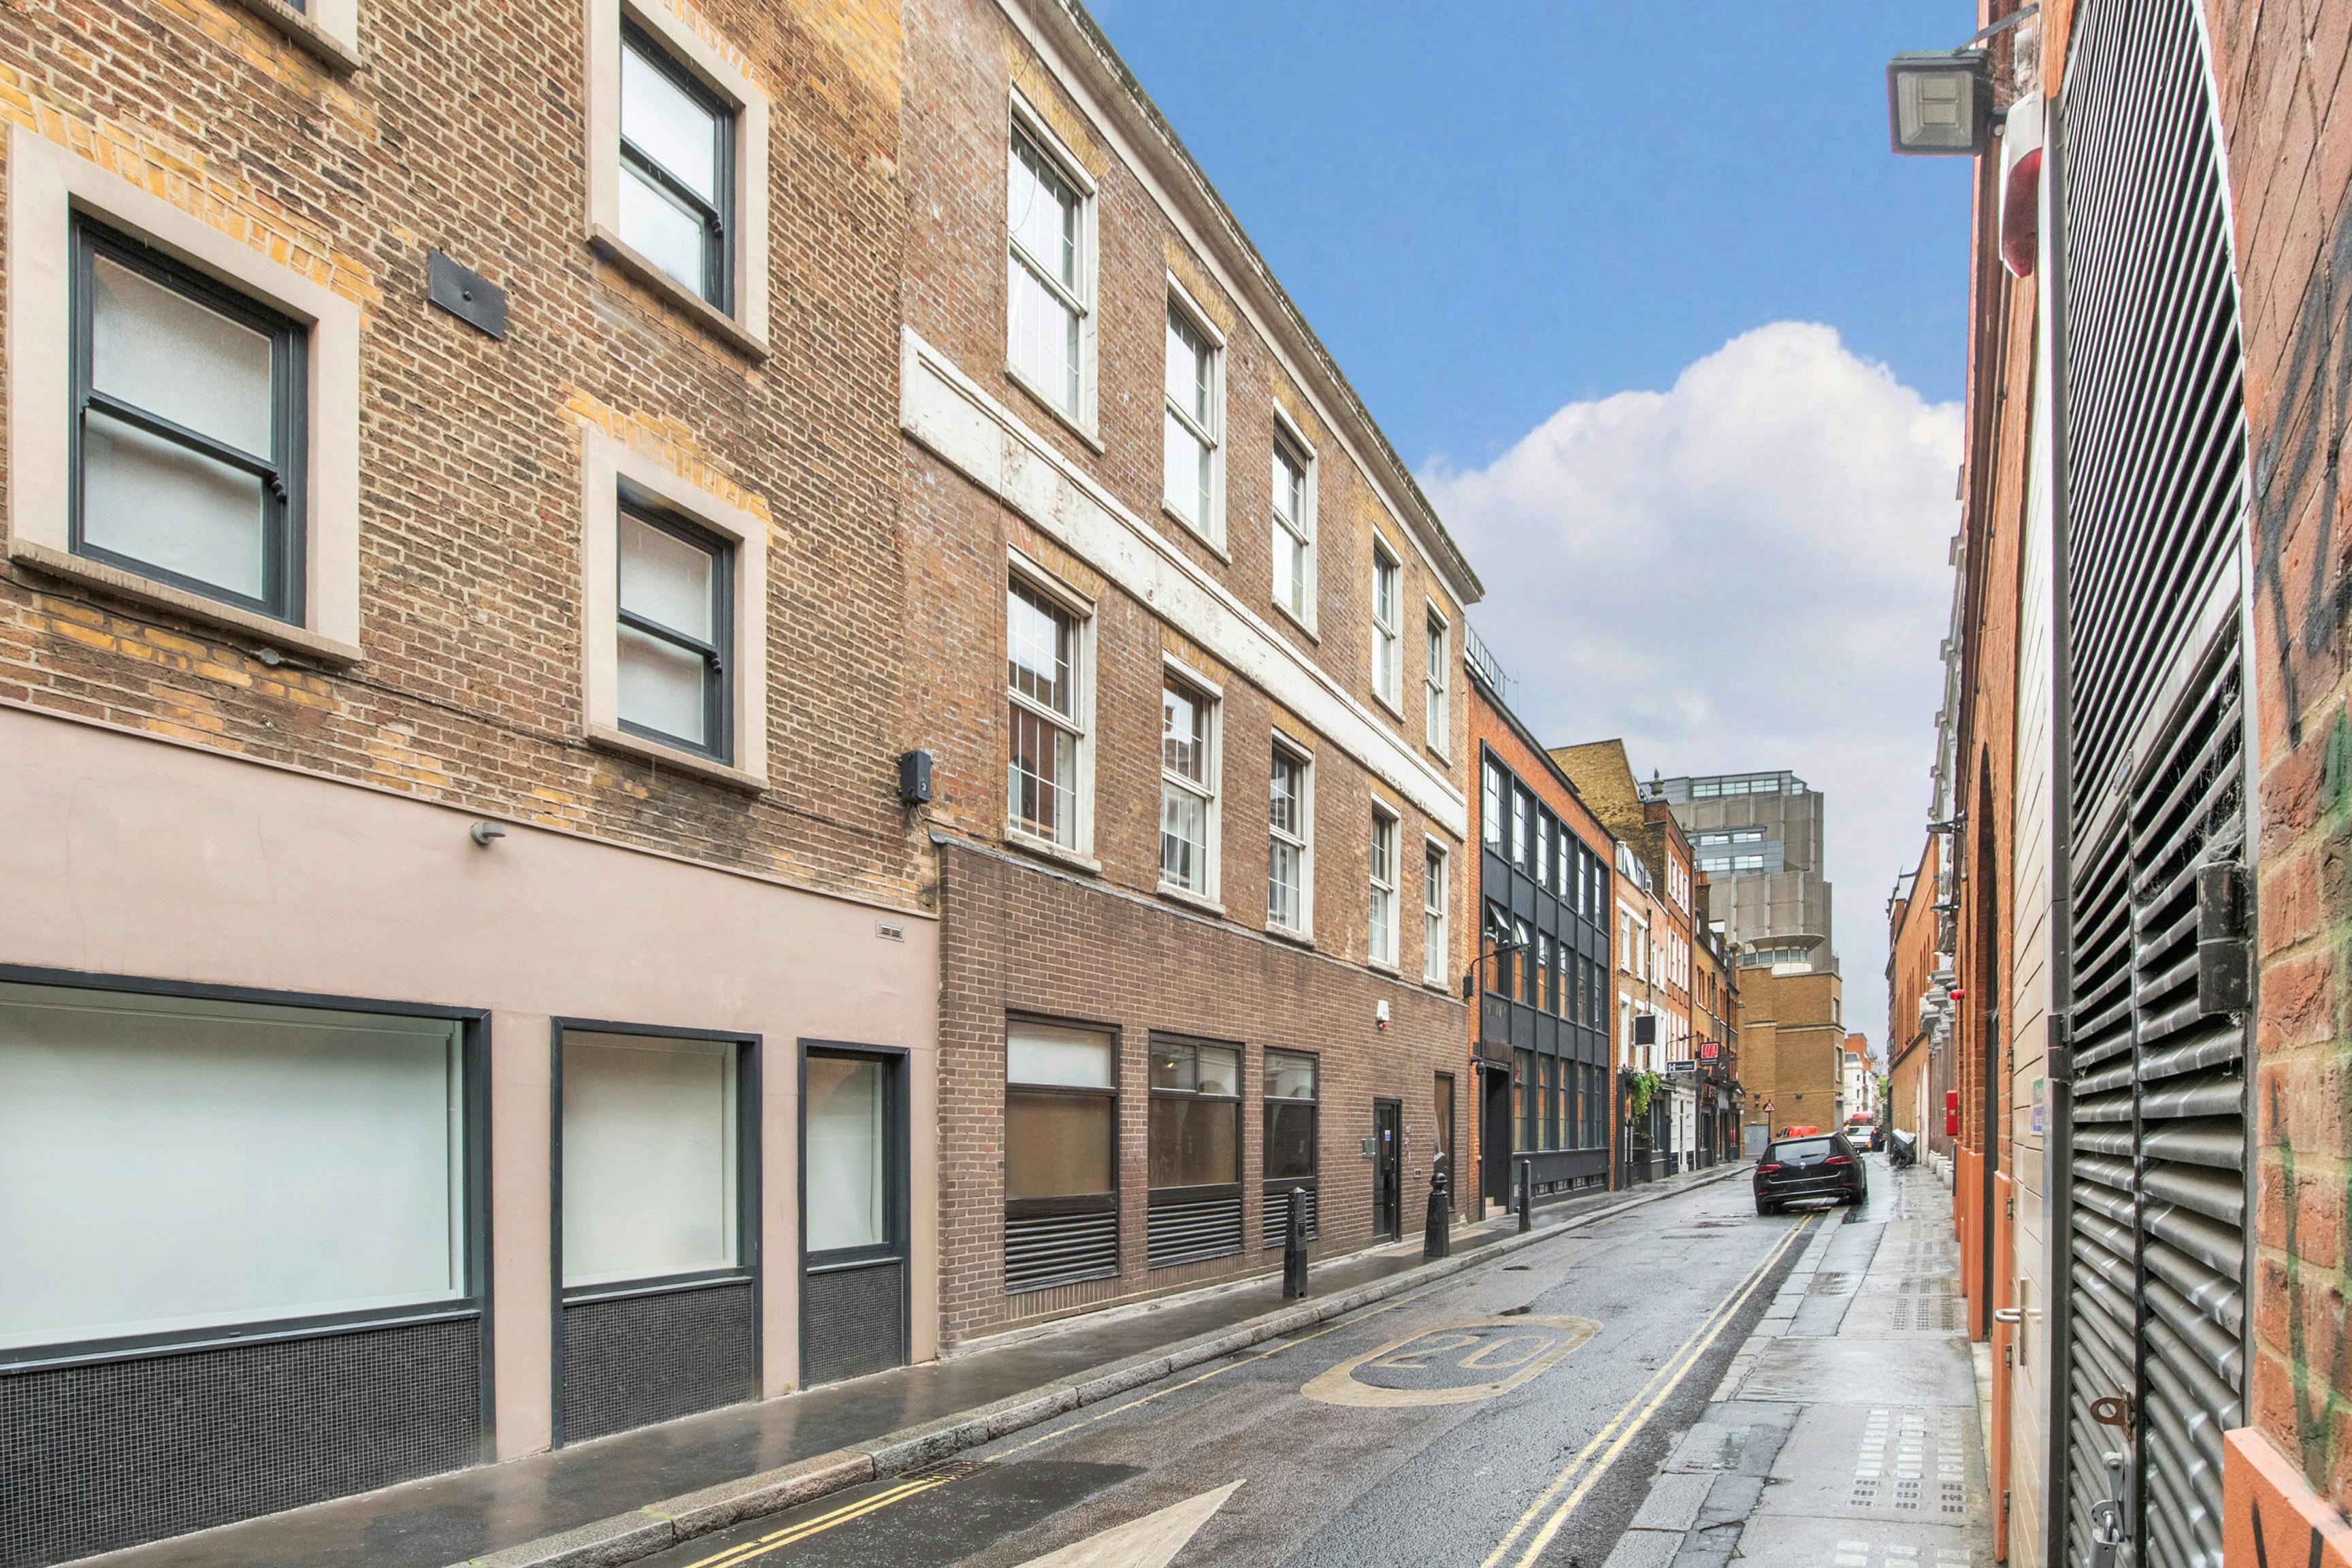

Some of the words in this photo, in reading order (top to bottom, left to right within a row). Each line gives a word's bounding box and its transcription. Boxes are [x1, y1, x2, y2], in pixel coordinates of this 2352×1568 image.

[921, 783, 926, 791] 3
[1669, 1063, 1676, 1071] H
[1369, 1335, 1555, 1369] 20
